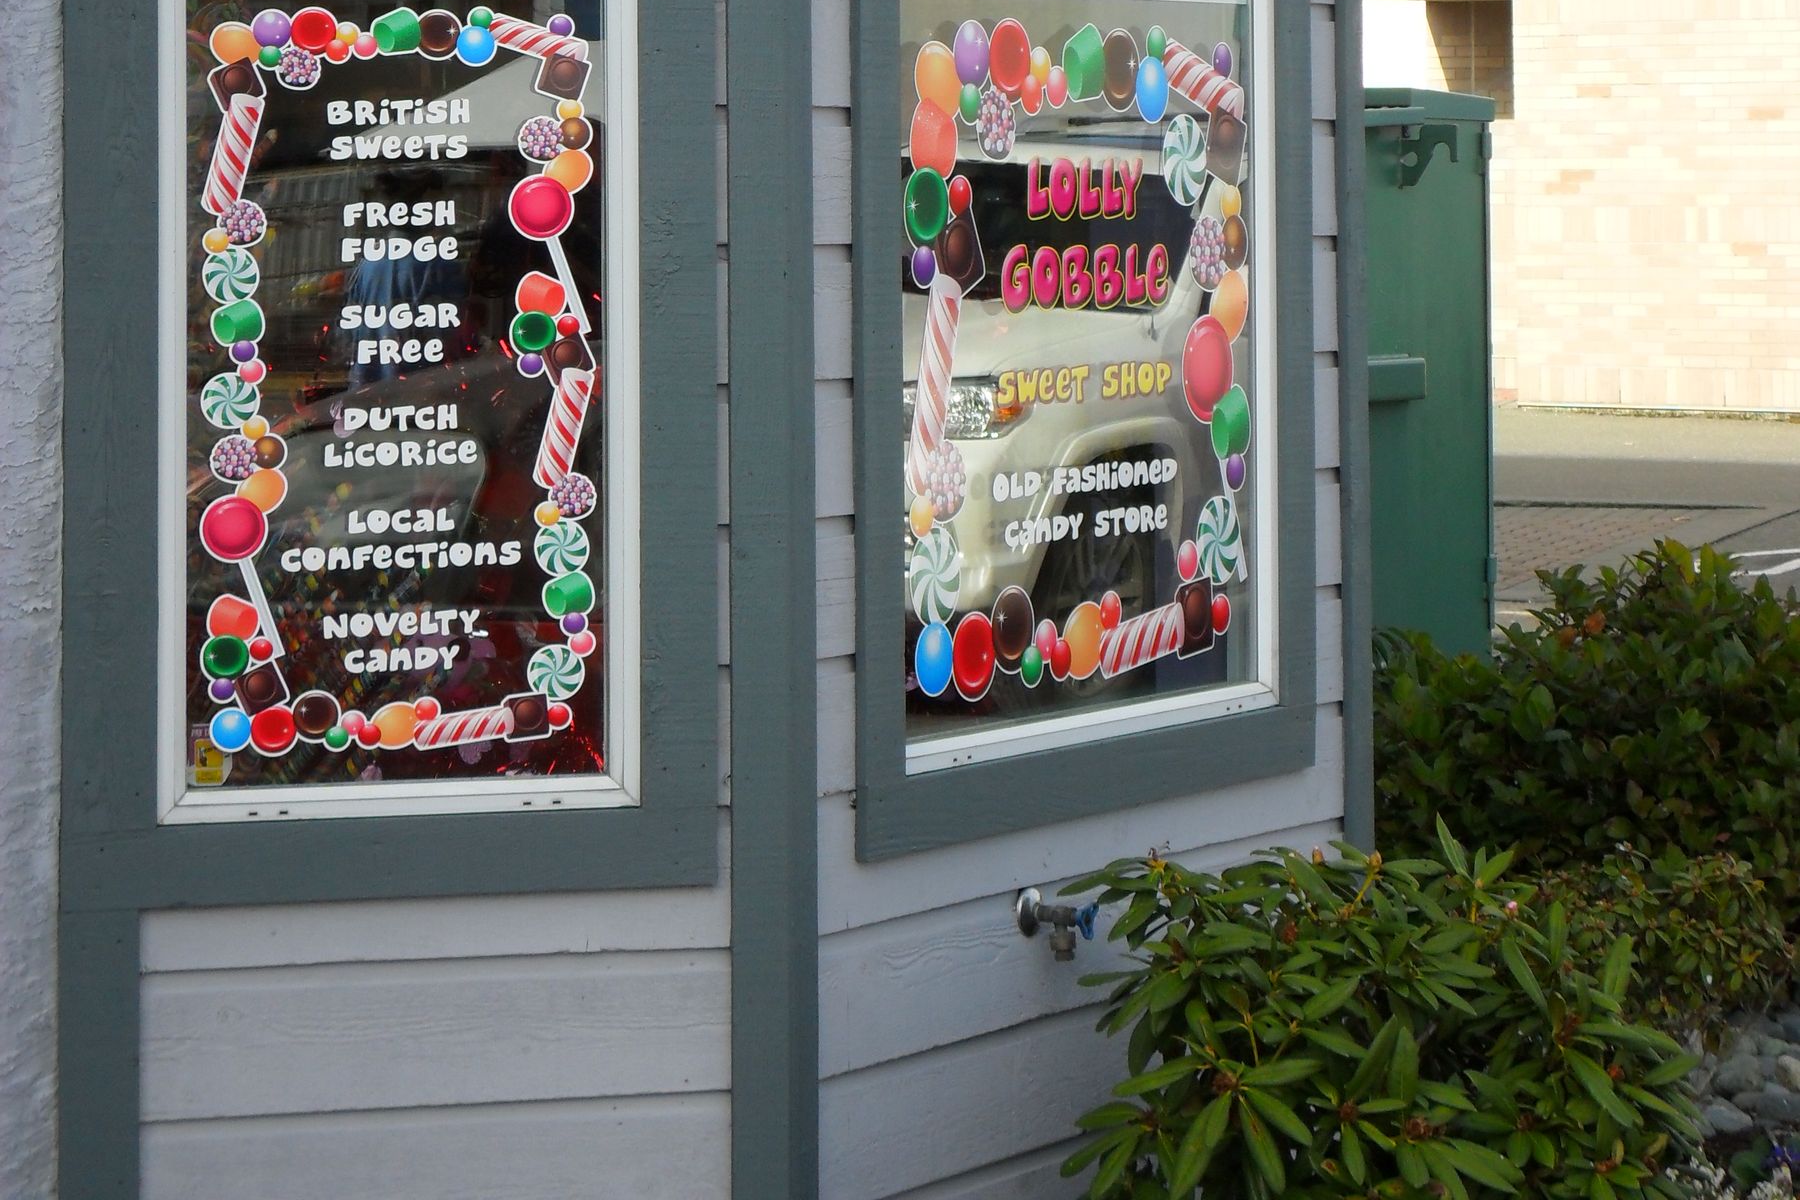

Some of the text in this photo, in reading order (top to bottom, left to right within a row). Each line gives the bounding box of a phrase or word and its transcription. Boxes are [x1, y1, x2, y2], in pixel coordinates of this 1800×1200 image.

[1026, 155, 1144, 222] LOLLY
[1101, 360, 1173, 400] SHOP
[343, 403, 459, 432] DUTCH
[992, 471, 1042, 503] OLD
